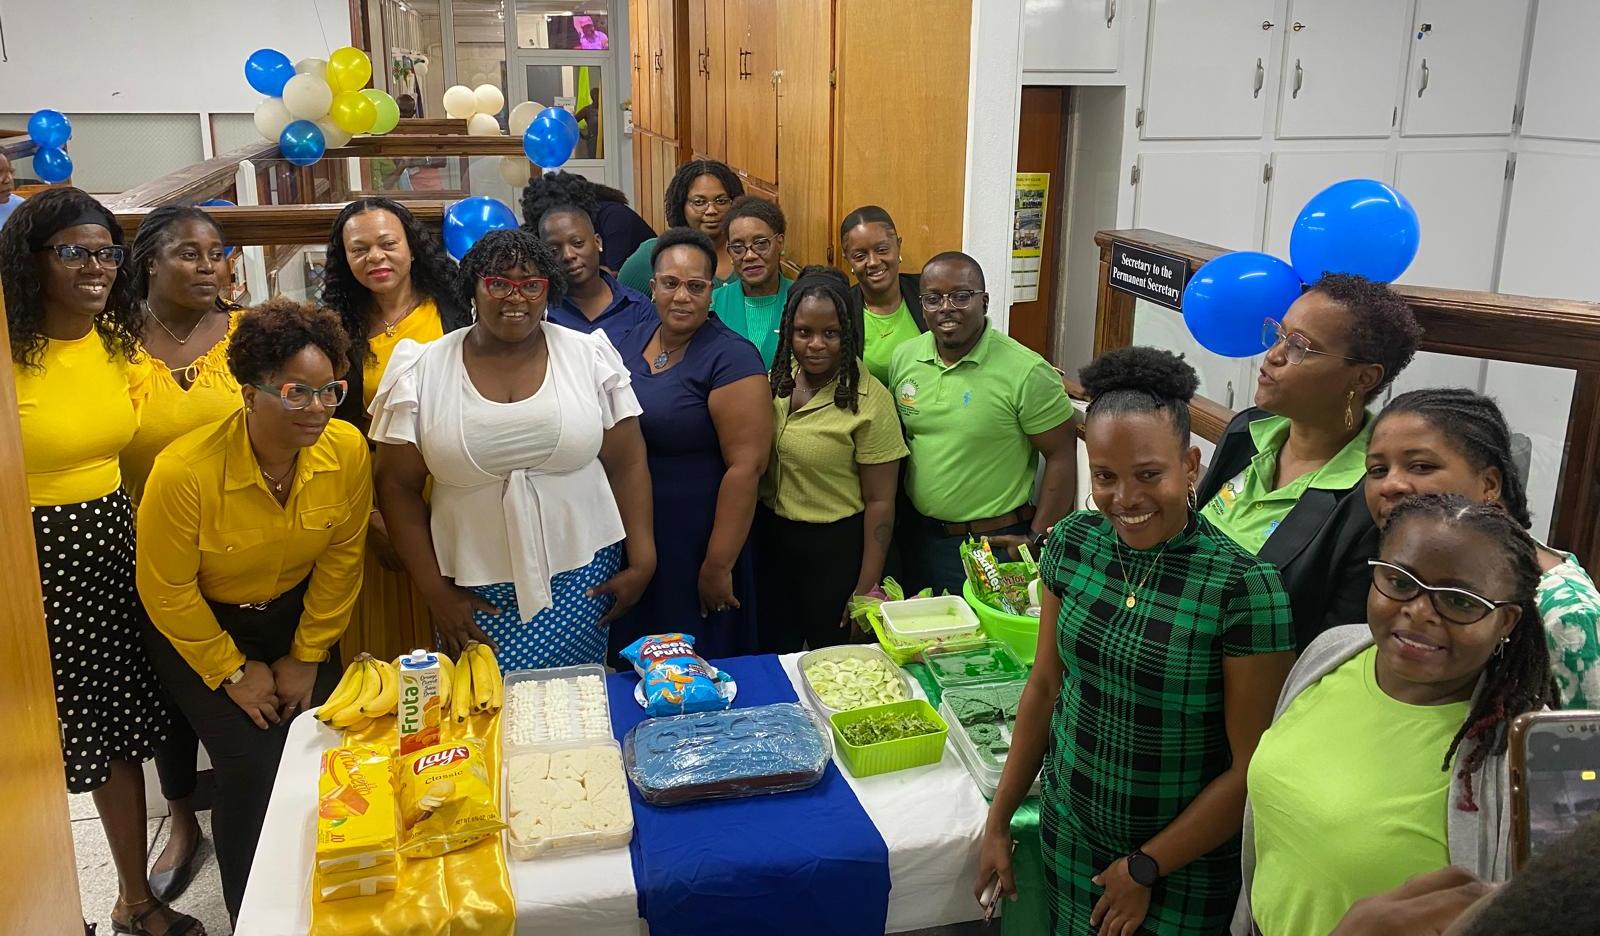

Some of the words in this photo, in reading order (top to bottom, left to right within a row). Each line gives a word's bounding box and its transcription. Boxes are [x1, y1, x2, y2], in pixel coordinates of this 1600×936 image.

[1121, 253, 1151, 275] Secretary
[1152, 264, 1159, 275] to
[1161, 265, 1172, 279] the
[1112, 266, 1146, 288] Permanent
[1147, 278, 1180, 301] Secretary
[972, 549, 1000, 591] Skittles
[643, 640, 693, 656] Cheese
[653, 647, 694, 658] Puffs
[401, 687, 418, 734] Fruta
[425, 770, 463, 785] Classic
